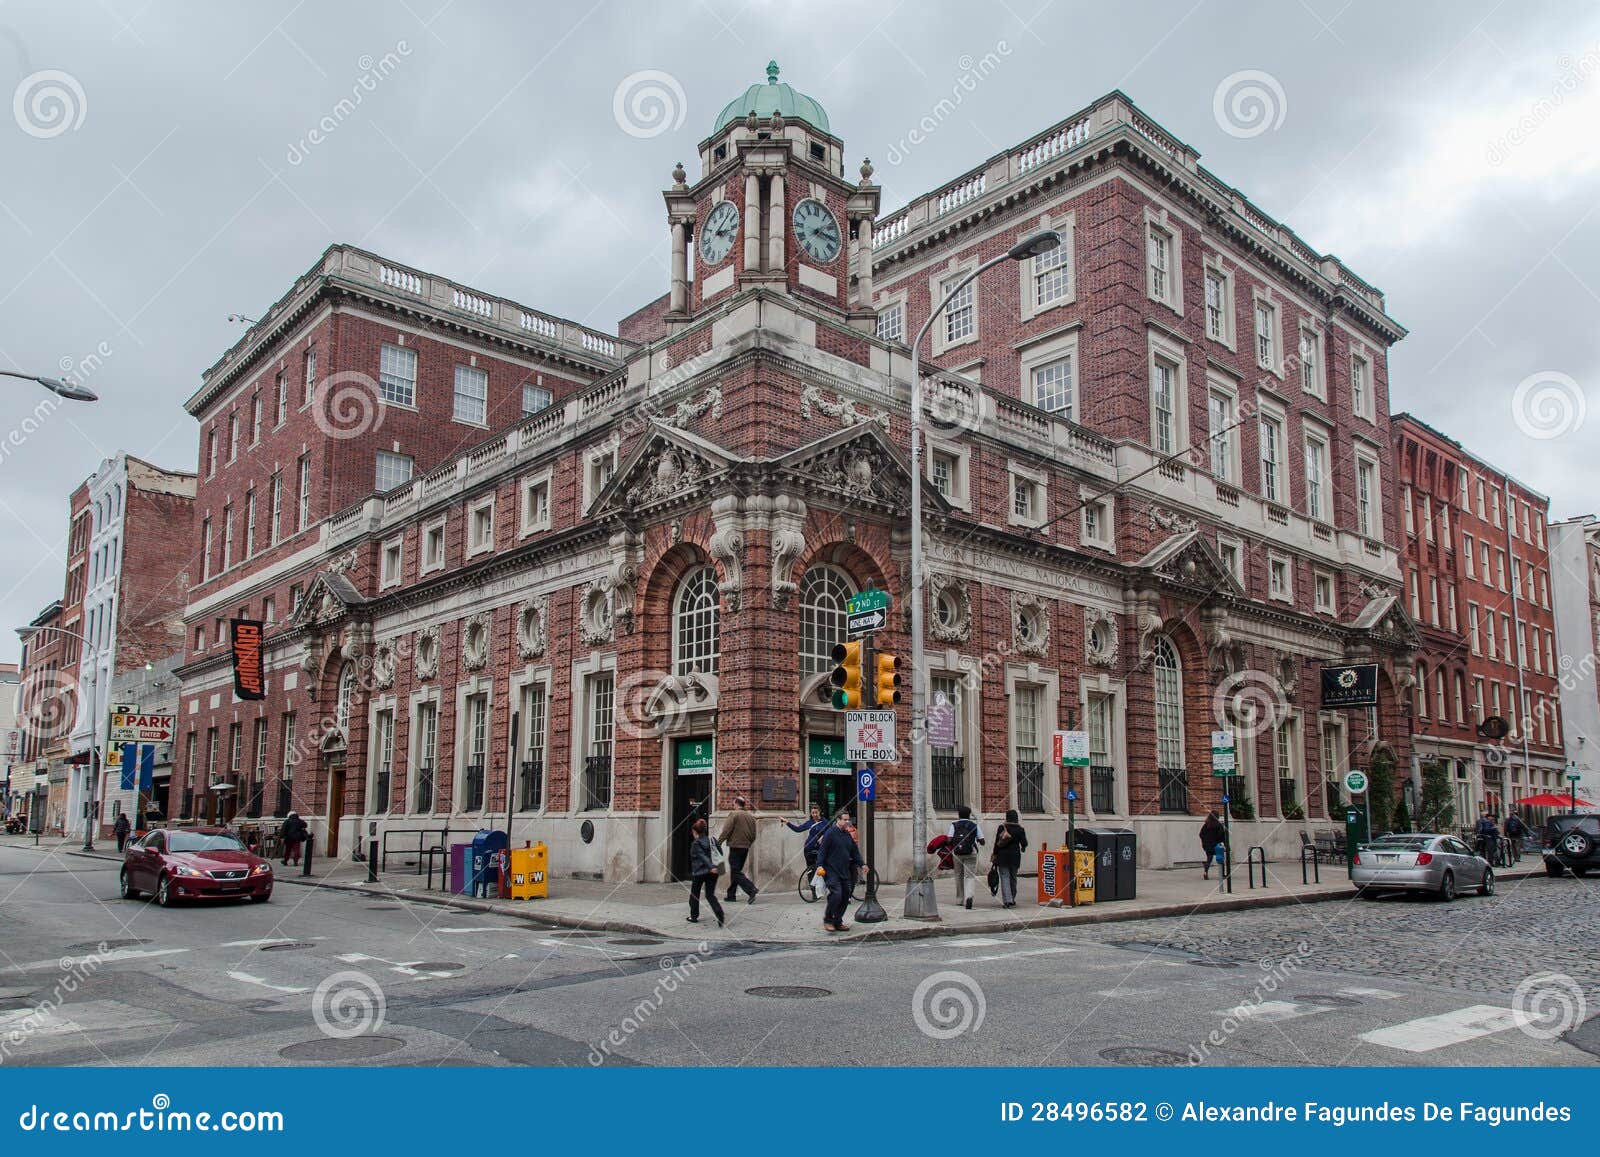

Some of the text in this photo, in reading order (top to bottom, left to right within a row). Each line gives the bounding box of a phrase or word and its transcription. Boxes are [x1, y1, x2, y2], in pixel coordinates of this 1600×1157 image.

[855, 599, 871, 612] 2ND
[126, 716, 172, 728] PARK
[869, 713, 893, 722] BLOCK
[848, 750, 893, 760] THE BOX
[702, 757, 713, 765] Ban
[808, 756, 831, 765] Citizens
